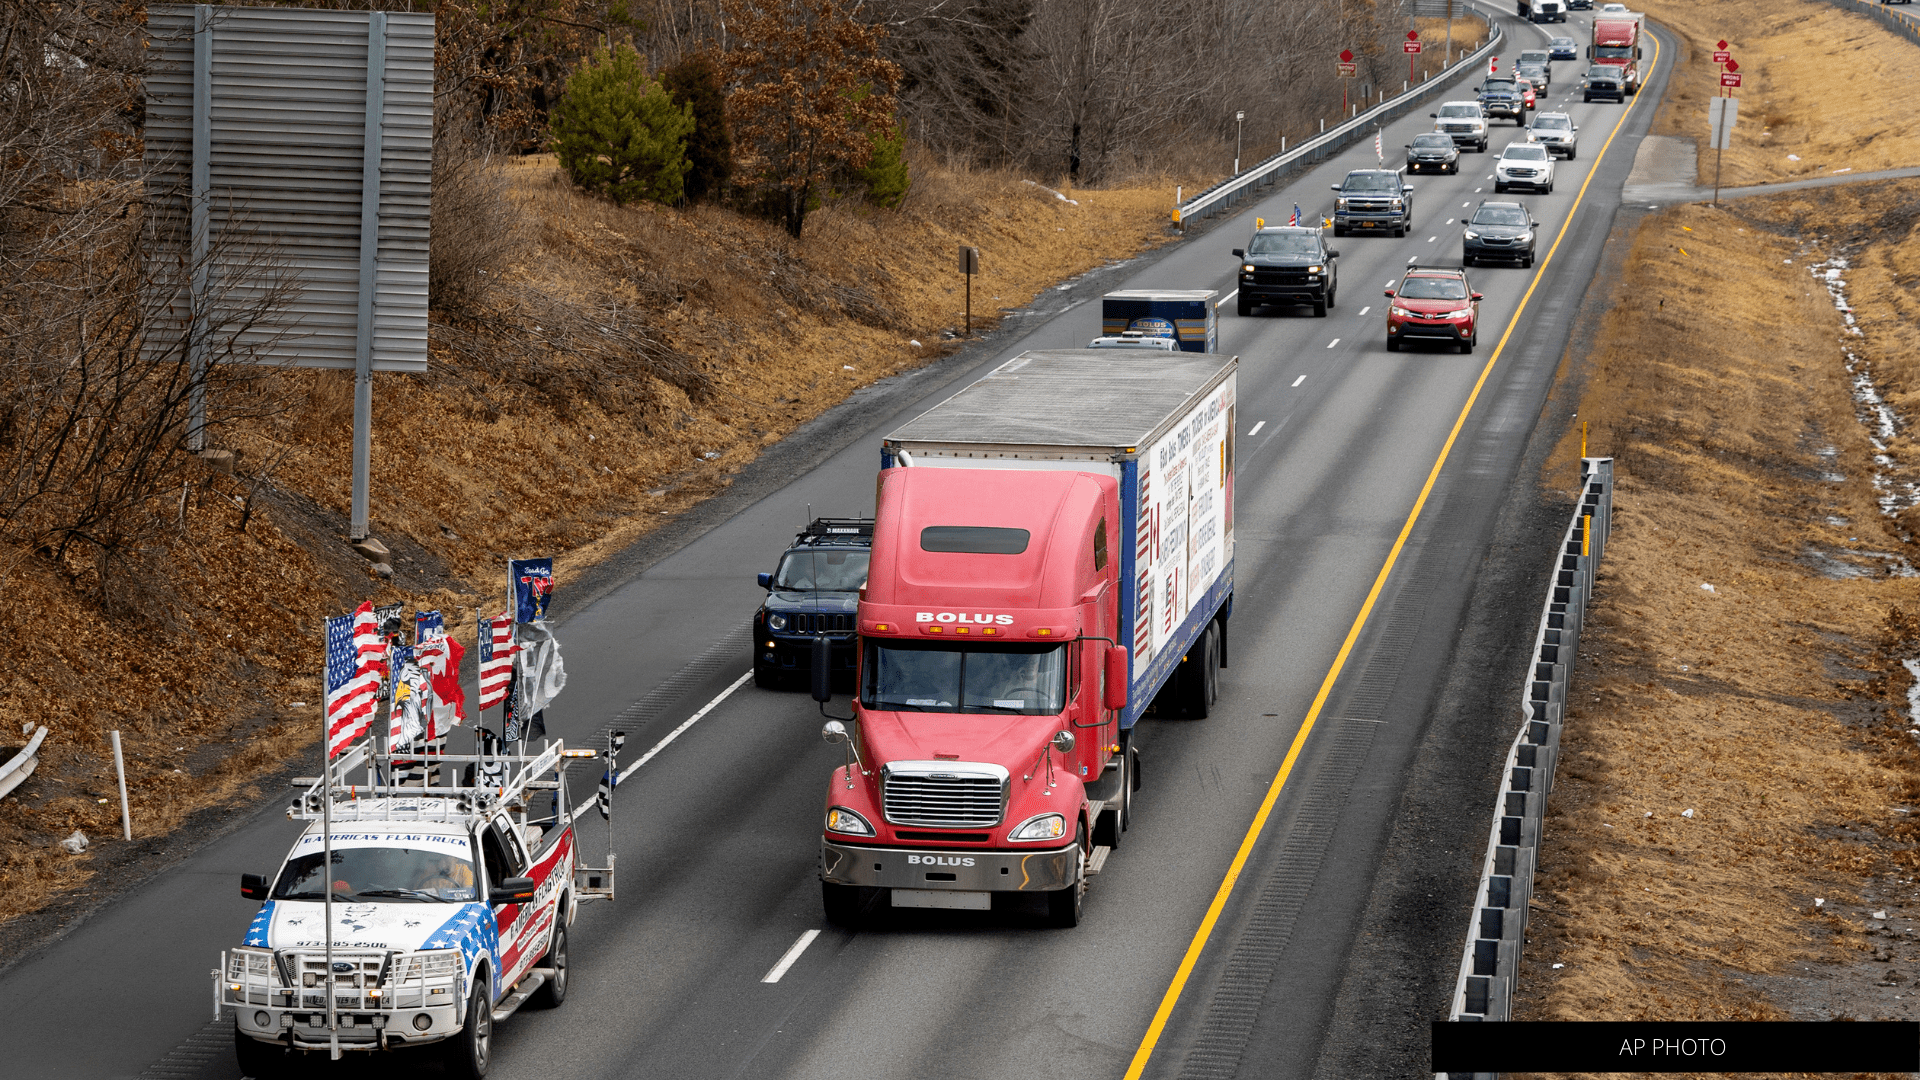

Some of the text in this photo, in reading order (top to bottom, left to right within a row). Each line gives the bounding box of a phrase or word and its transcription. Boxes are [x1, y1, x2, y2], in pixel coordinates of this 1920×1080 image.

[916, 612, 1014, 625] BOLUS
[425, 835, 467, 847] TRUCK
[908, 855, 976, 867] BOLUS
[296, 941, 387, 949] 973-85-2506
